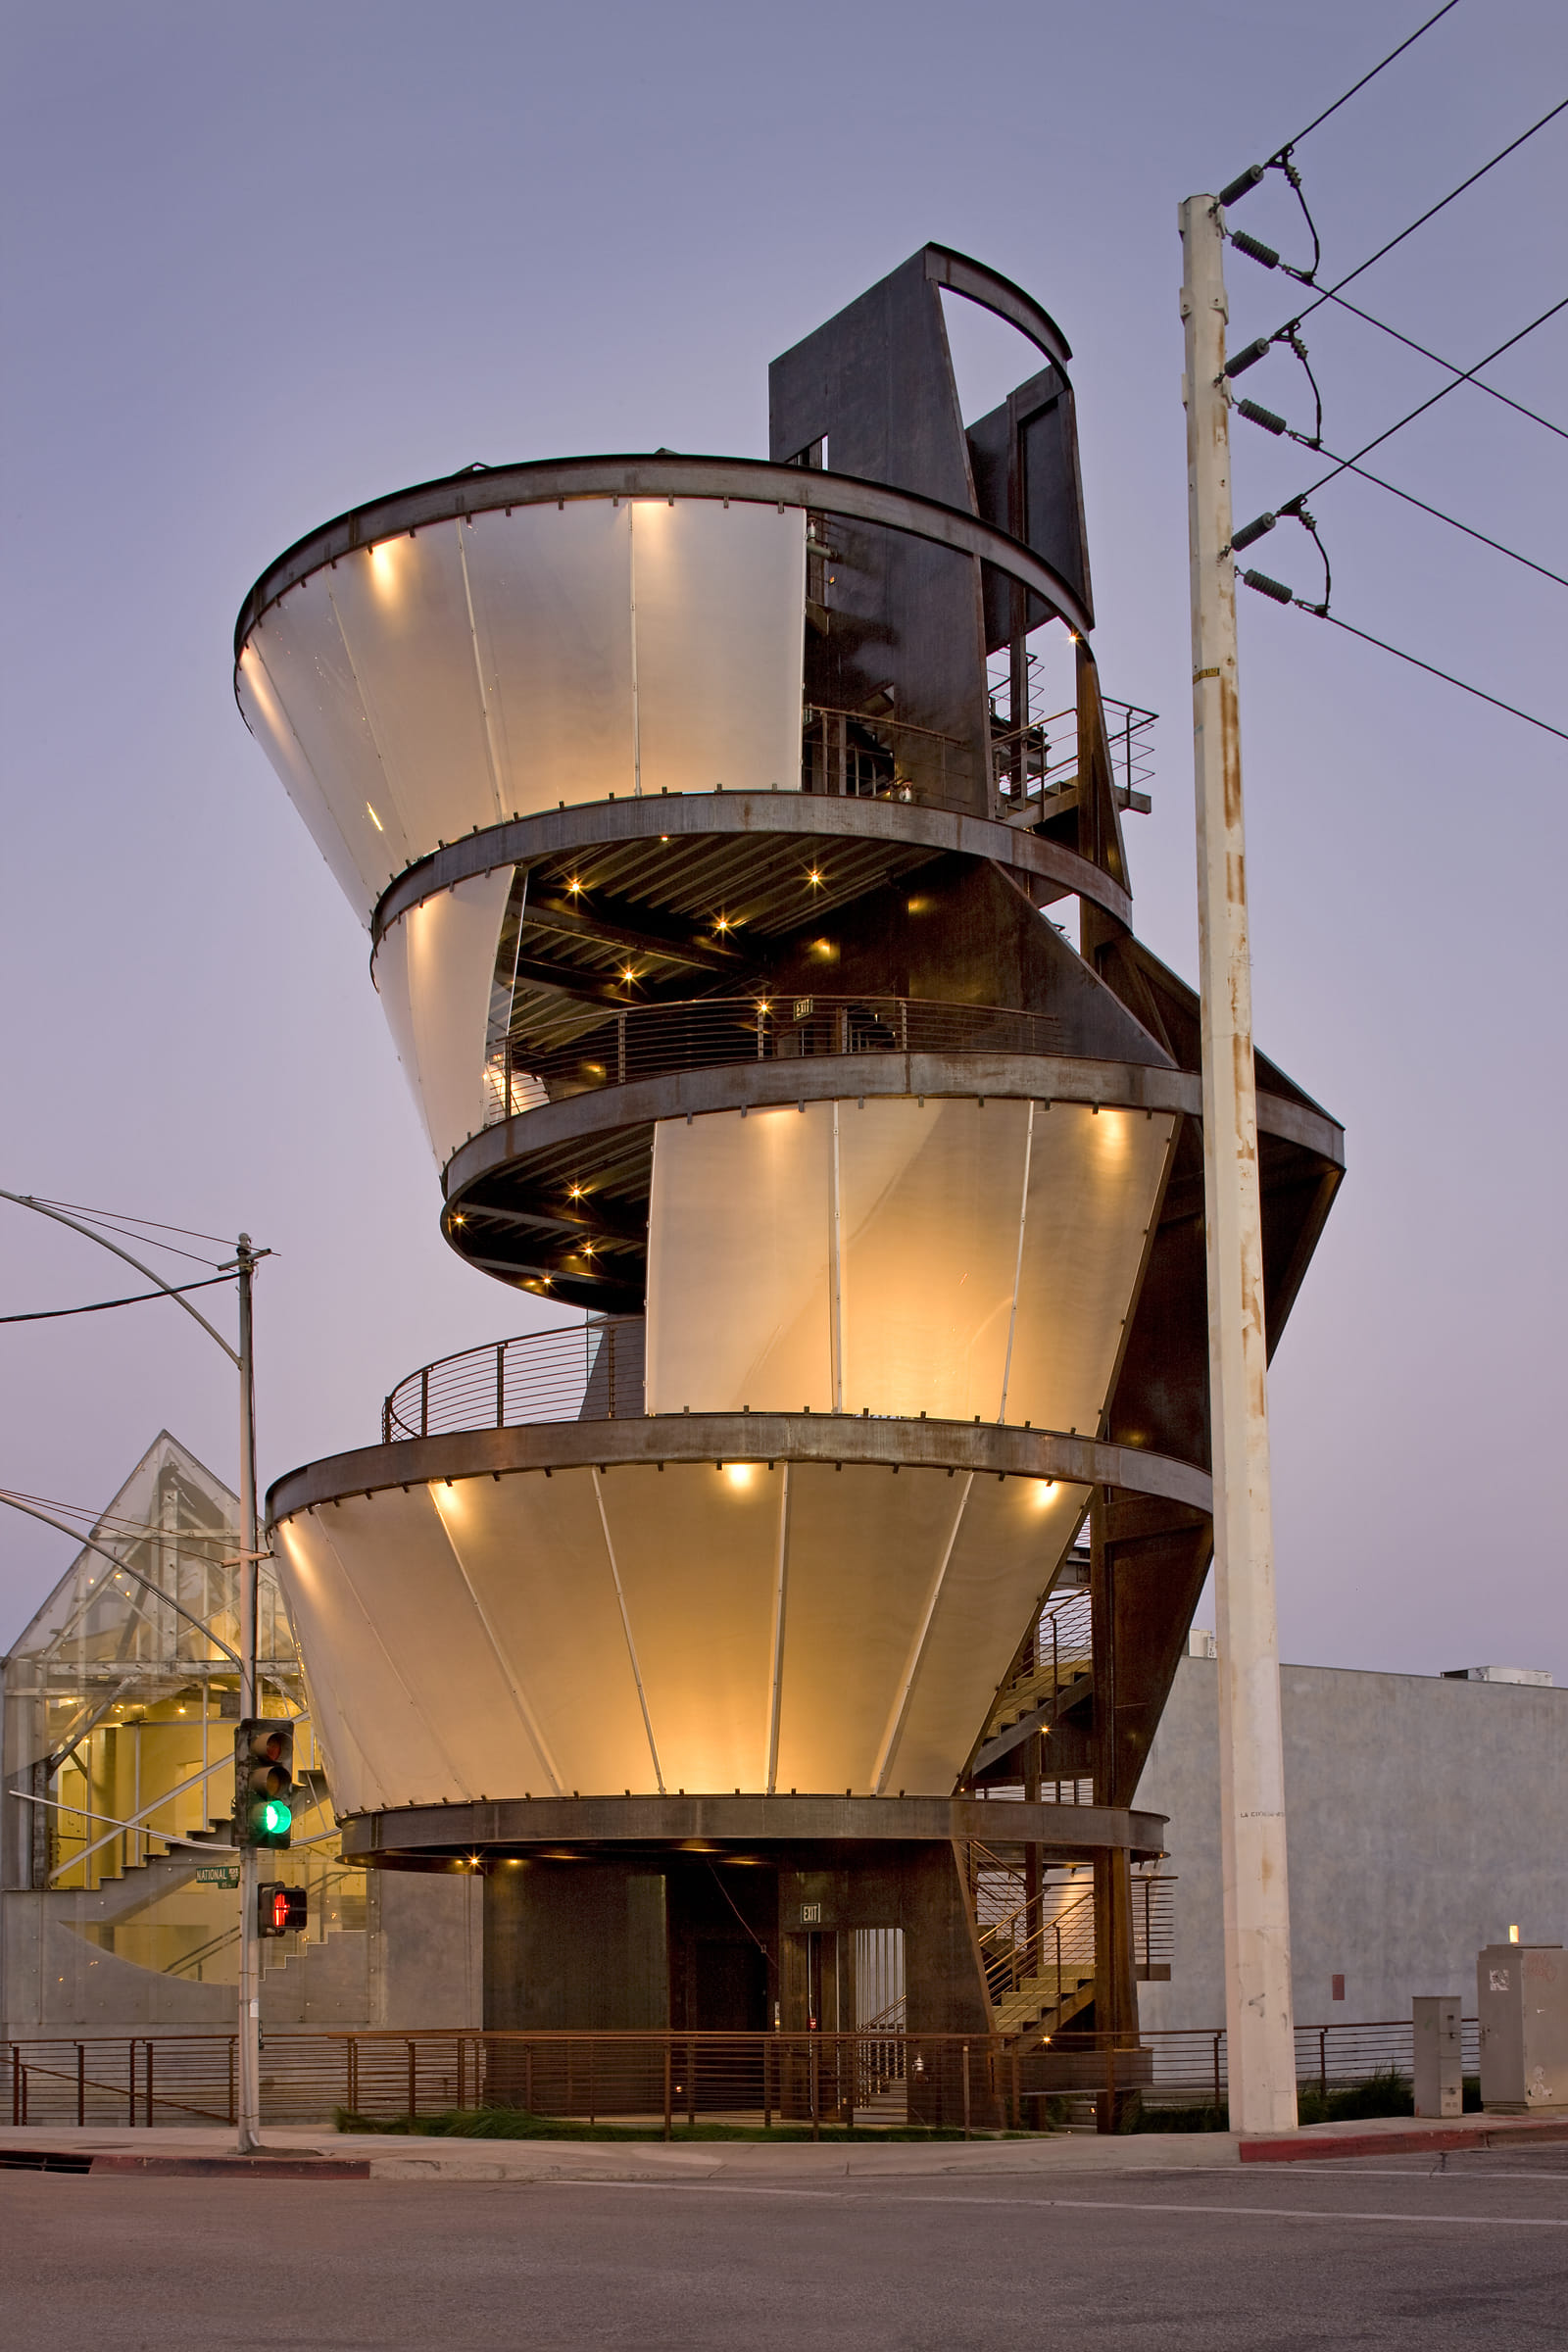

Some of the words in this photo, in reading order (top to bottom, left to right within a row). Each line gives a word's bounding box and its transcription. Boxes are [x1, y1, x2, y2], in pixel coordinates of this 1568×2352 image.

[796, 999, 809, 1017] EXIT
[196, 1868, 227, 1881] NATIONAL
[803, 1905, 817, 1922] EXIT
